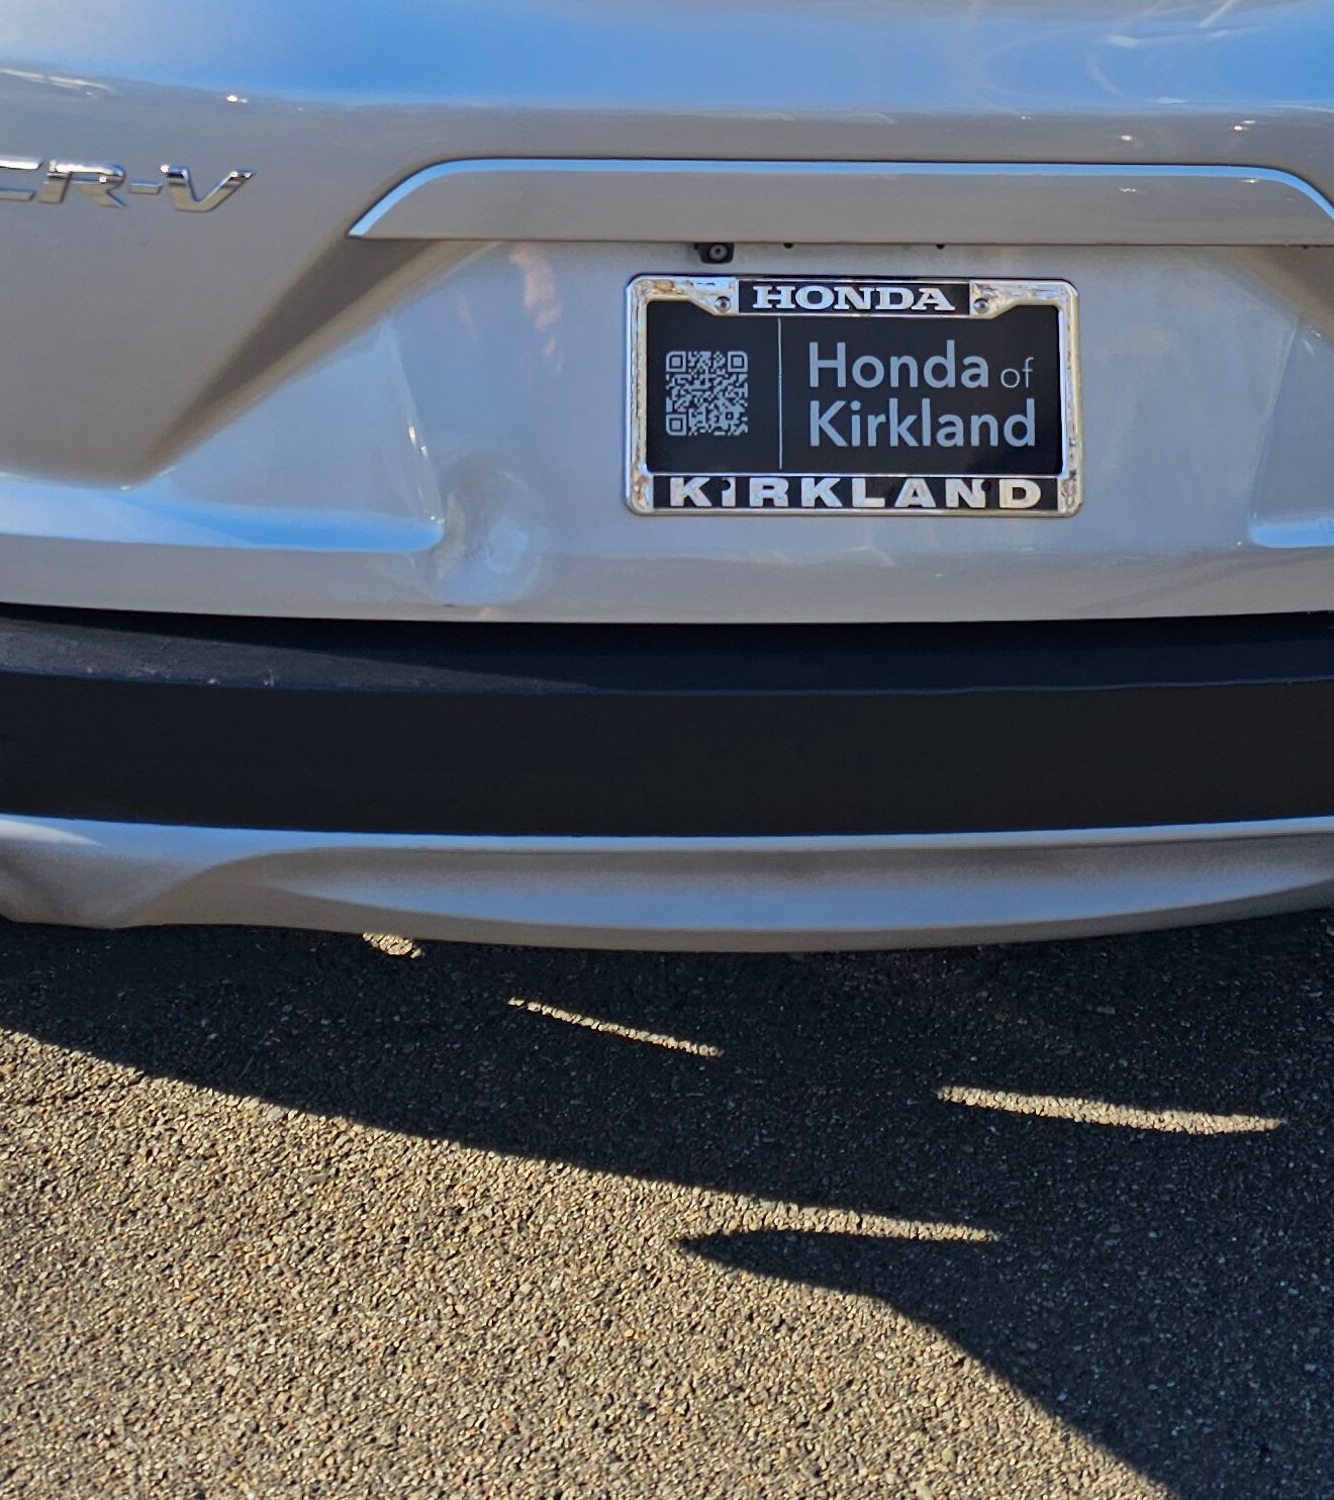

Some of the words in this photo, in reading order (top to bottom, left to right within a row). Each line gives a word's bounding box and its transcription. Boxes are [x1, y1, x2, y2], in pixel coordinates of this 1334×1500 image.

[753, 285, 956, 311] HONDA
[808, 340, 989, 388] Honda
[1000, 356, 1036, 389] of
[808, 397, 1037, 447] Kirkland
[668, 477, 1043, 509] KIRKLAND
